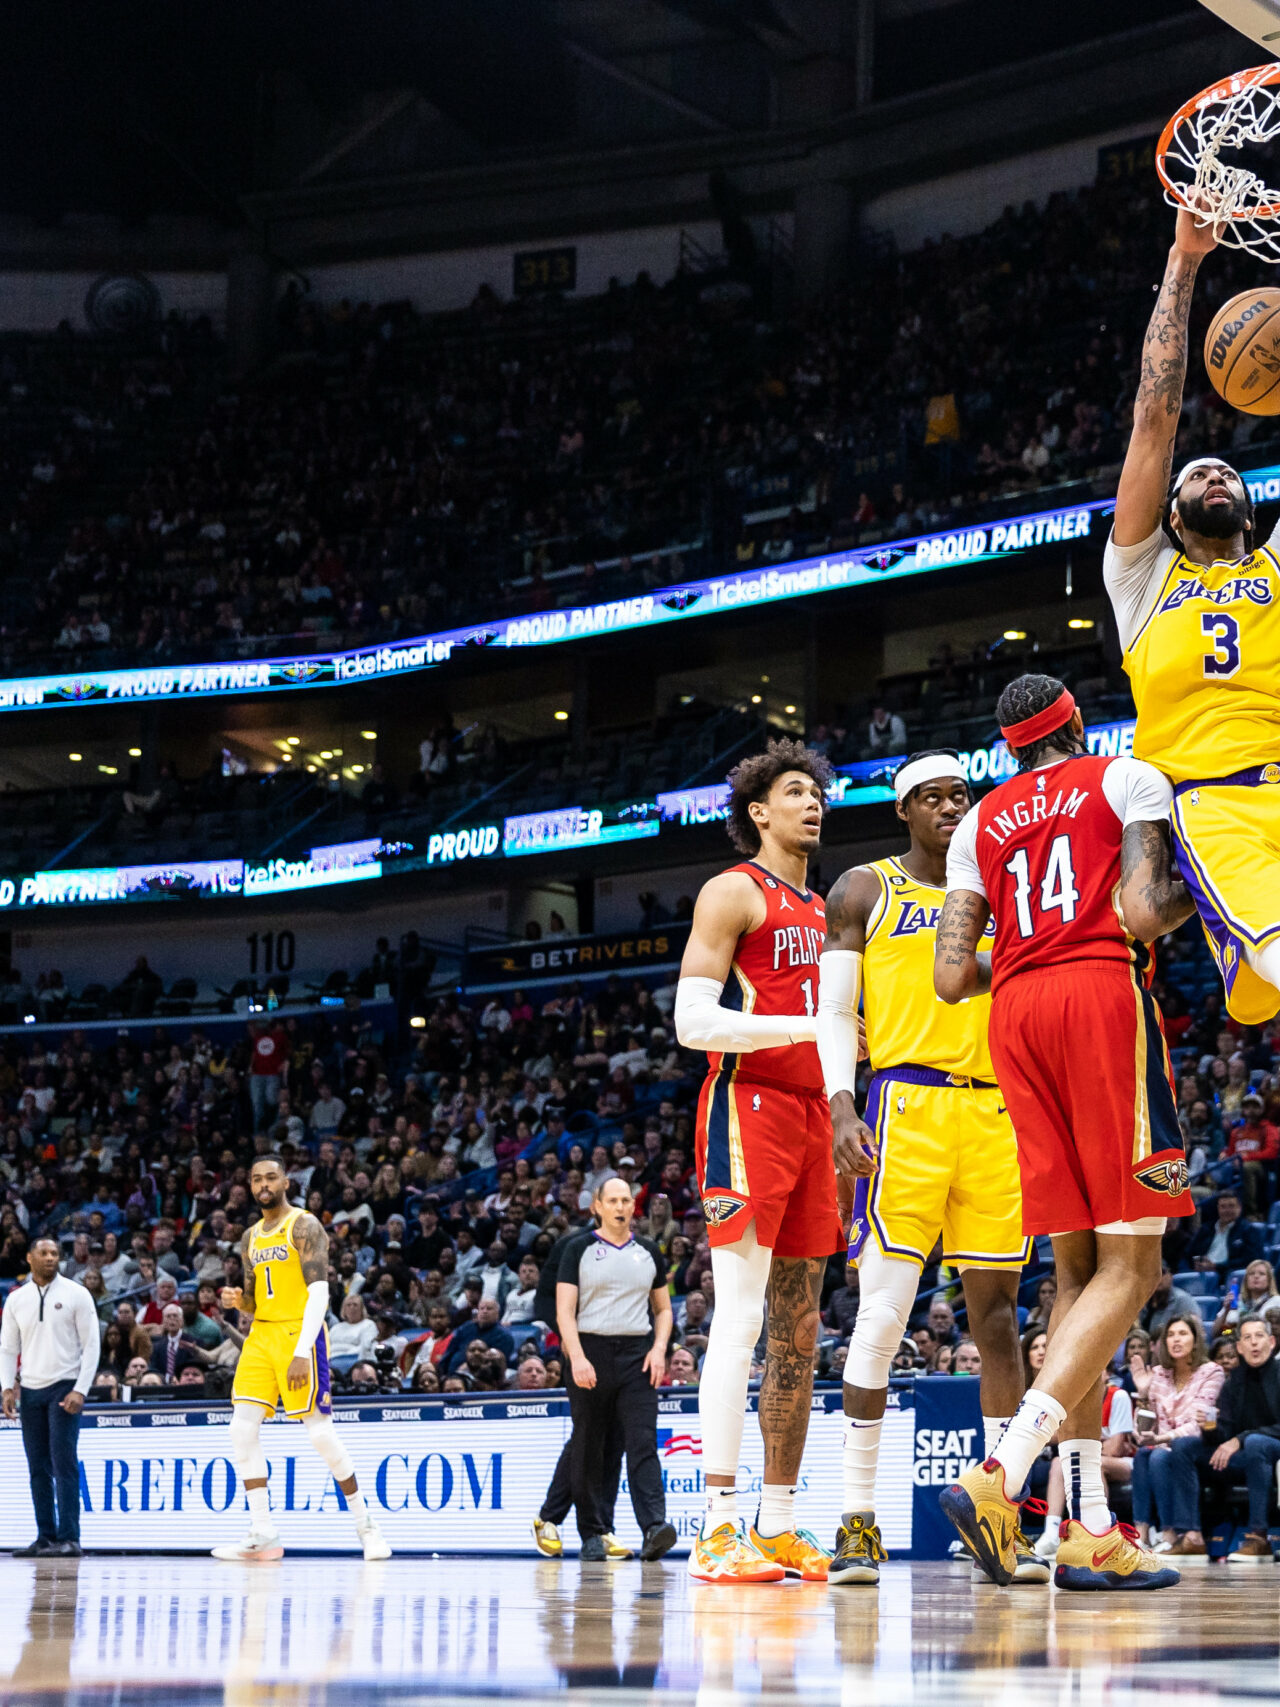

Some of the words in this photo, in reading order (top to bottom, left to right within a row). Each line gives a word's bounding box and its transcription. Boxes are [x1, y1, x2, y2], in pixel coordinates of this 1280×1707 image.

[1209, 300, 1271, 369] Wilson
[915, 528, 987, 567] PROUD
[991, 510, 1091, 553] PARTNER
[709, 559, 856, 607] TicketSmarter
[1238, 559, 1266, 576] bibigo
[1158, 576, 1273, 616] LAKERS
[505, 613, 567, 647] PROUD
[569, 596, 654, 636] PARTNER
[333, 640, 455, 680] TicketSmarter
[1201, 612, 1241, 680] 3
[106, 668, 173, 698] PROUD
[178, 663, 271, 693] PARTNER
[984, 787, 1090, 846] INGRAM
[428, 825, 499, 863] PROUD
[1005, 833, 1080, 940] 14
[247, 931, 294, 972] 110
[530, 936, 669, 970] BETRIVERS
[773, 925, 826, 971] PELIC
[801, 977, 820, 1016] 1
[264, 1266, 274, 1299] 1
[381, 1408, 422, 1421] SEATGEEK
[443, 1406, 484, 1419] SEATGEEK
[506, 1403, 549, 1418] SEATGEEK
[916, 1428, 977, 1458] SEAT
